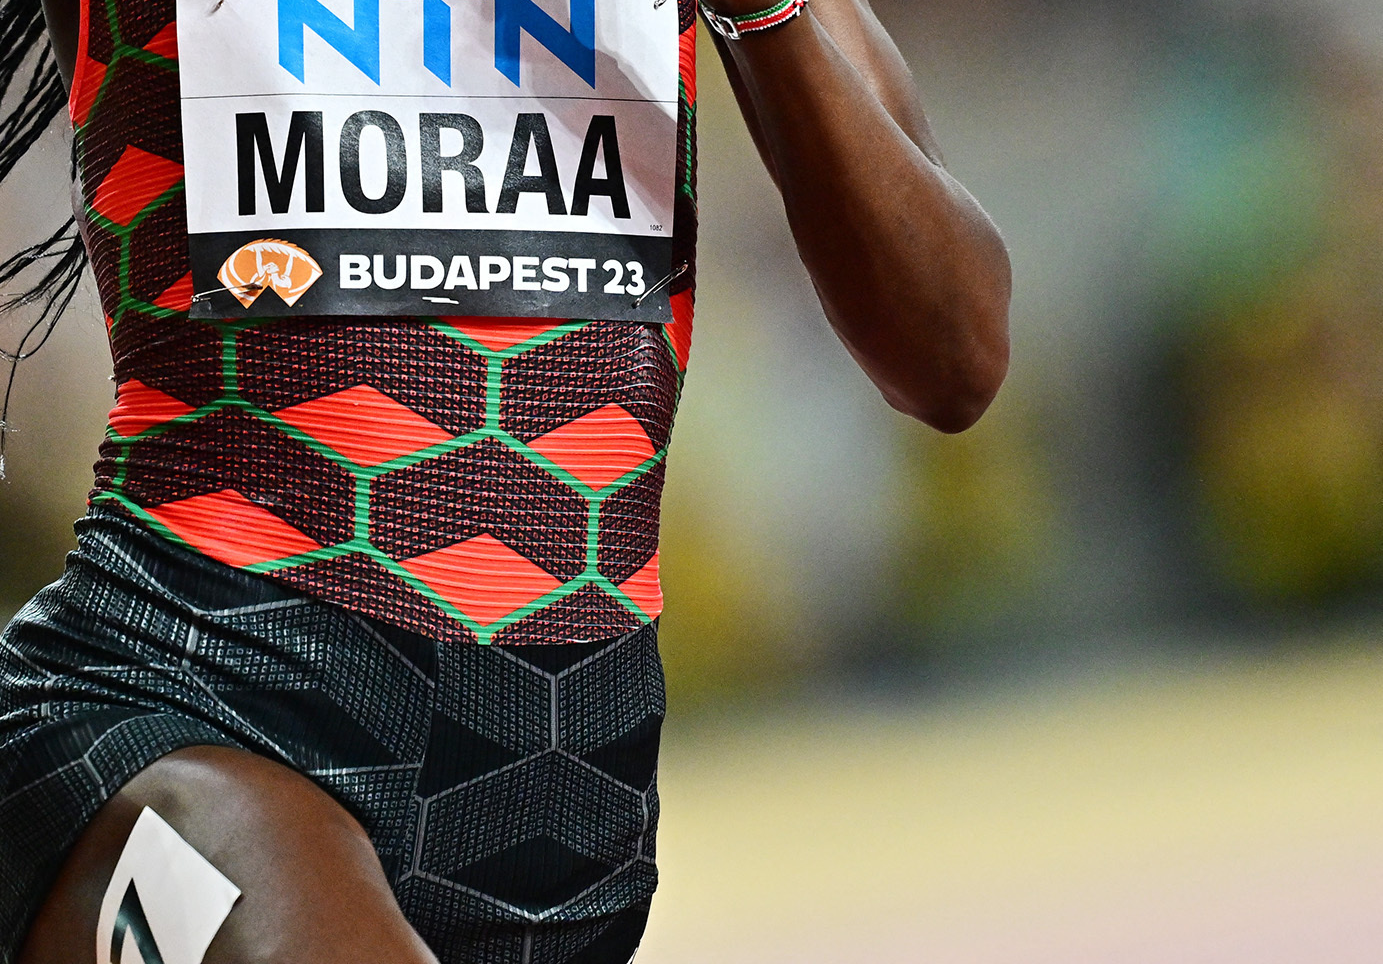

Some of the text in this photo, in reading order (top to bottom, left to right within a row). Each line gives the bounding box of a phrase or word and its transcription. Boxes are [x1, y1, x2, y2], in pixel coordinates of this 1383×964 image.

[235, 110, 631, 220] MORAA
[339, 254, 646, 297] BUDAPEST 23
